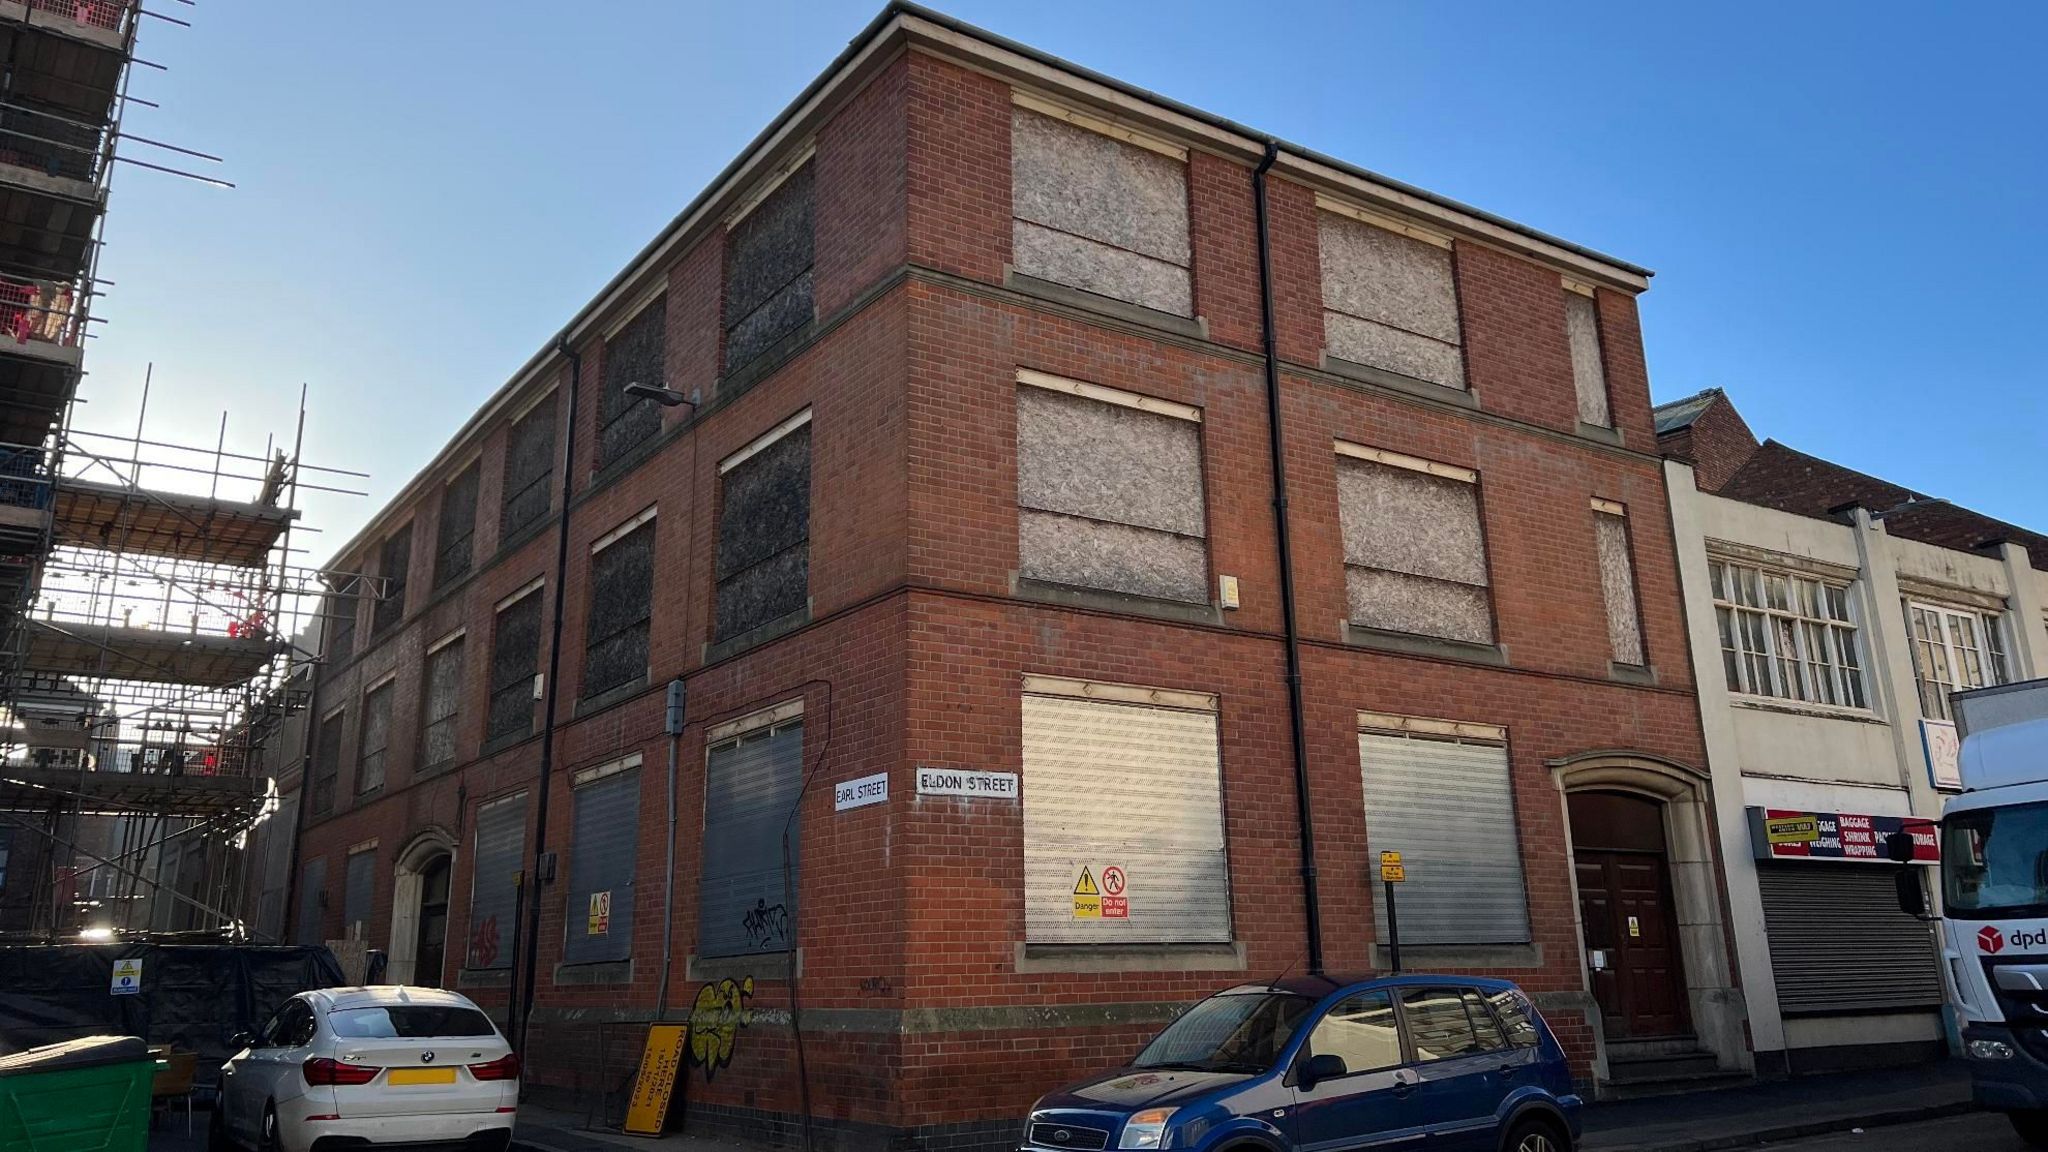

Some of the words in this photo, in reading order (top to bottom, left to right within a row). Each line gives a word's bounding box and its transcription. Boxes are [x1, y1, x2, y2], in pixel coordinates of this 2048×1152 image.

[921, 774, 962, 789] ELDON
[966, 777, 1014, 792] STREET
[836, 787, 855, 803] EARL
[857, 780, 886, 799] STREET
[1840, 816, 1870, 828] BAGGAGE
[1844, 831, 1871, 842] SHRINK
[1912, 833, 1935, 846] TORAGE
[1843, 844, 1877, 856] WRAPPING
[1075, 902, 1099, 911] Danger
[1103, 898, 1113, 906] Do
[2010, 928, 2047, 950] dpd
[670, 1029, 685, 1068] ROAD
[655, 1059, 670, 1097] HERE
[654, 1073, 674, 1129] CLOSED
